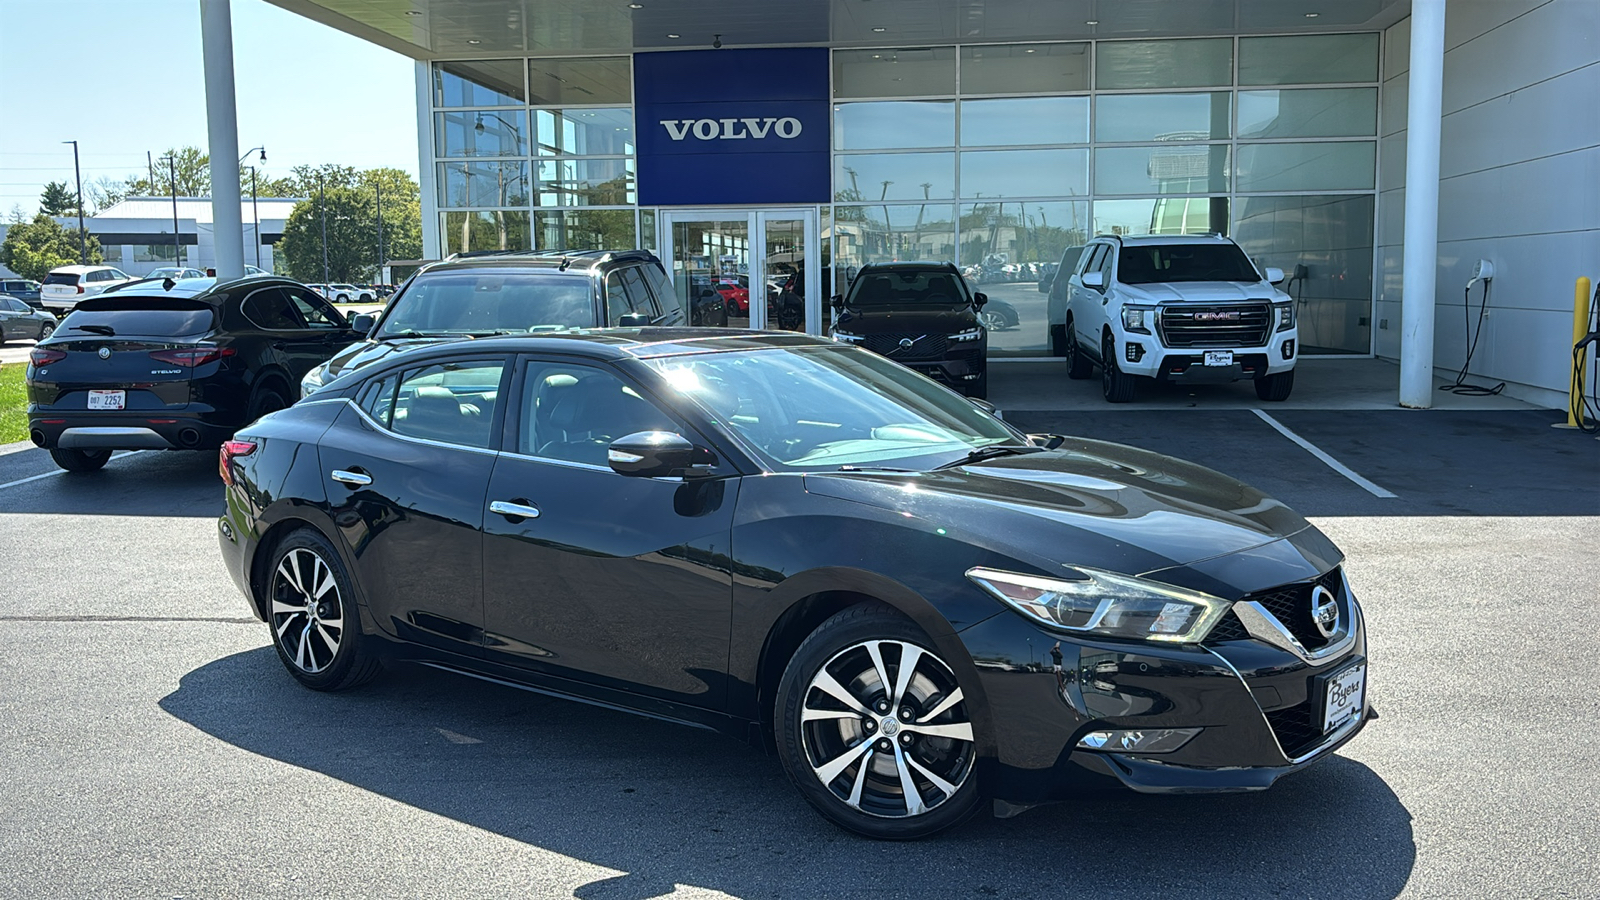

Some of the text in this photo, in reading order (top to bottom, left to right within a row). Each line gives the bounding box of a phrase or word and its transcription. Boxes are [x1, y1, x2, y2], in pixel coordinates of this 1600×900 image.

[660, 117, 803, 141] VOLVO
[1195, 312, 1240, 320] GMC
[104, 395, 122, 405] 2252
[1329, 681, 1359, 707] Byers
